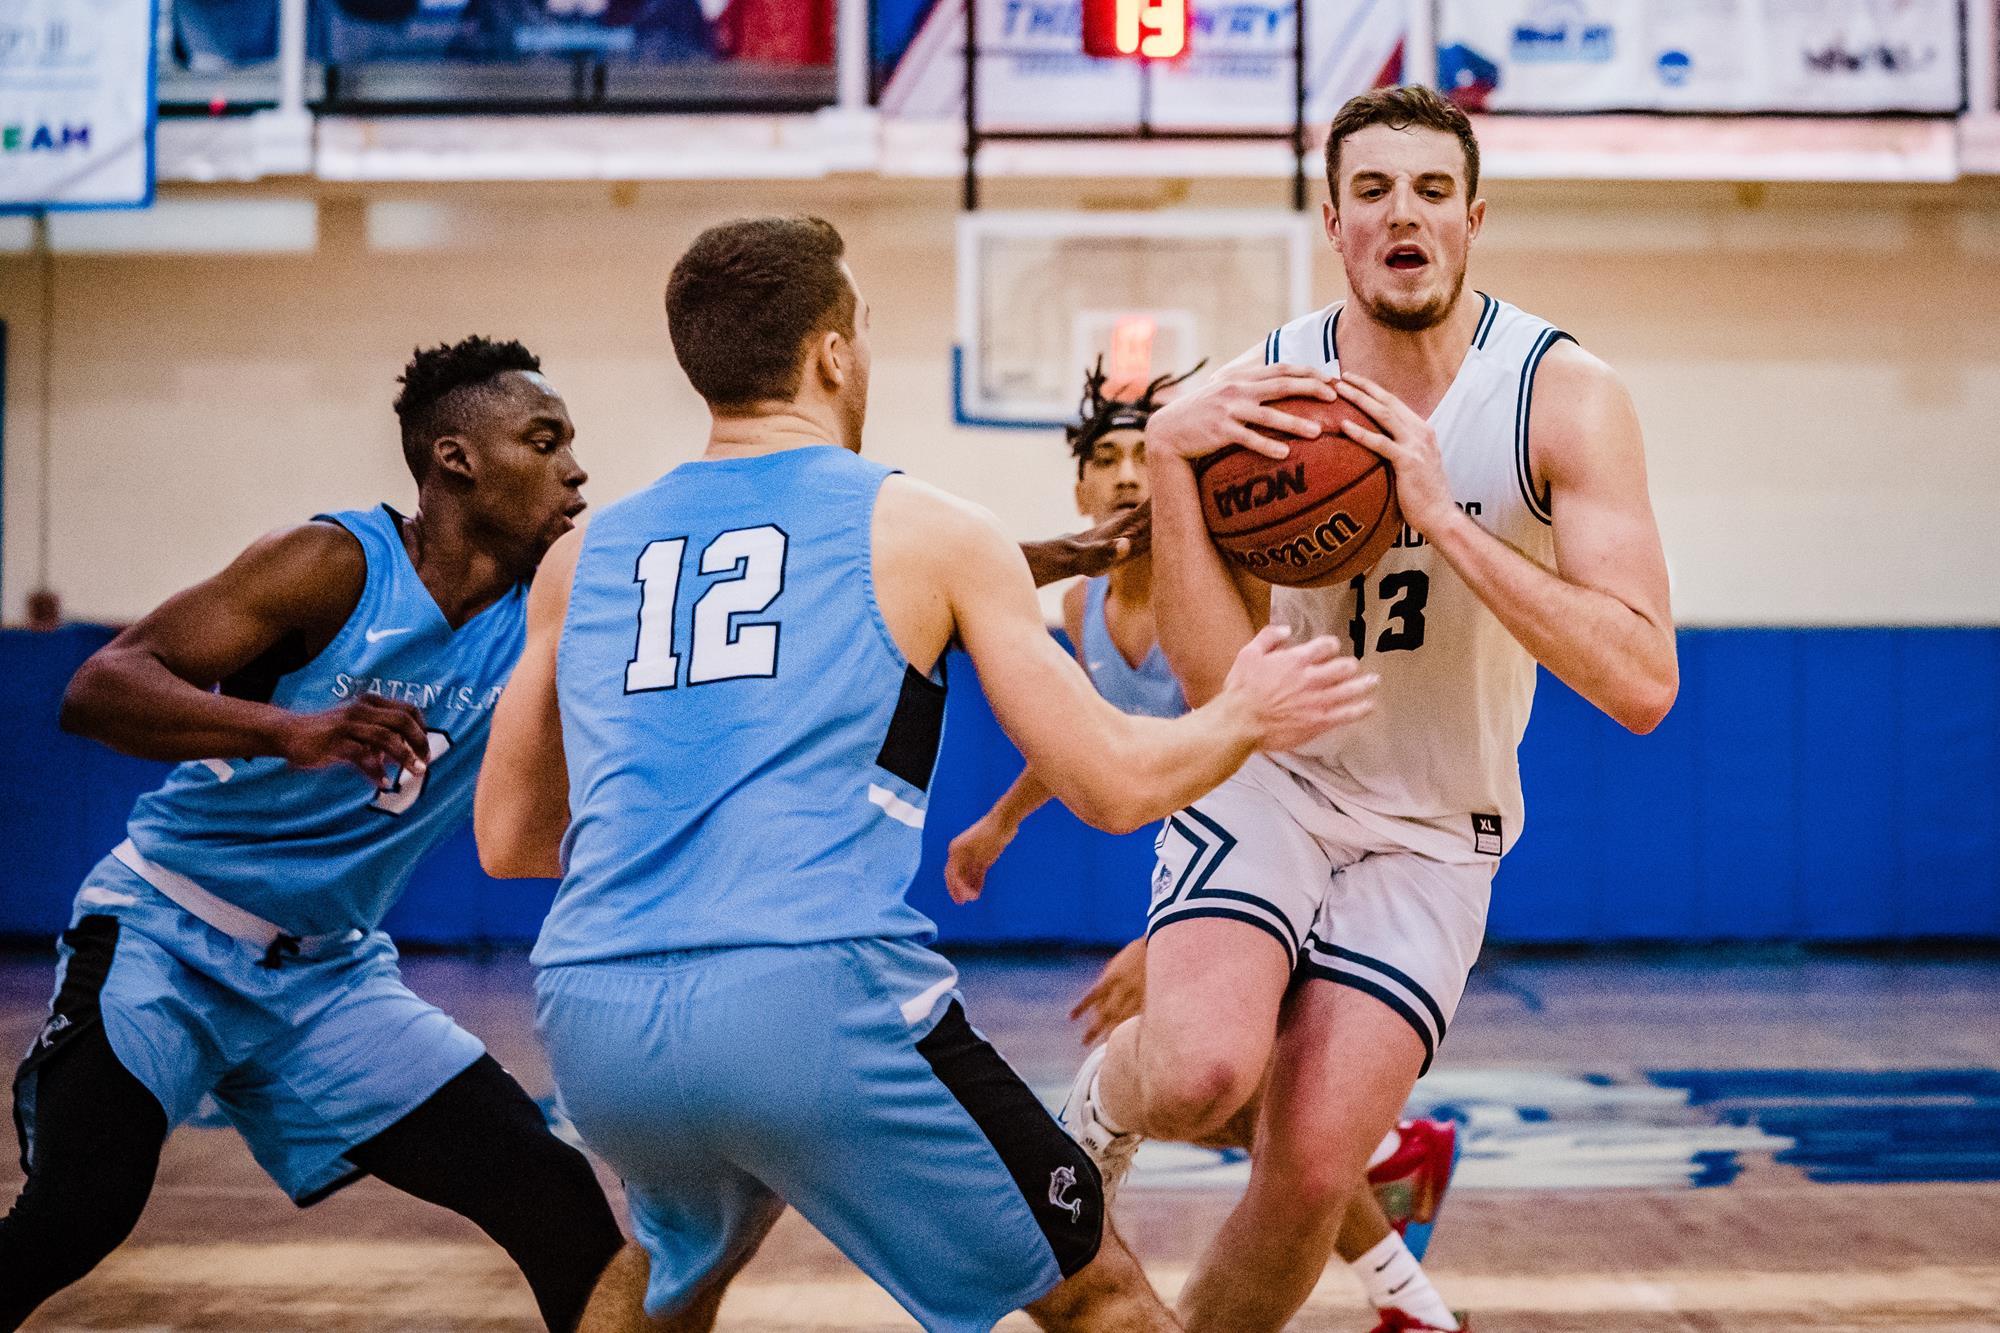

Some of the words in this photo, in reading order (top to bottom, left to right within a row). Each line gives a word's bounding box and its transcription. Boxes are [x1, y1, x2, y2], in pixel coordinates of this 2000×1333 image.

[1, 124, 91, 150] EAM
[1213, 462, 1308, 518] NCAA
[623, 523, 790, 695] 12
[1349, 569, 1430, 661] 13
[1479, 818, 1496, 832] XL
